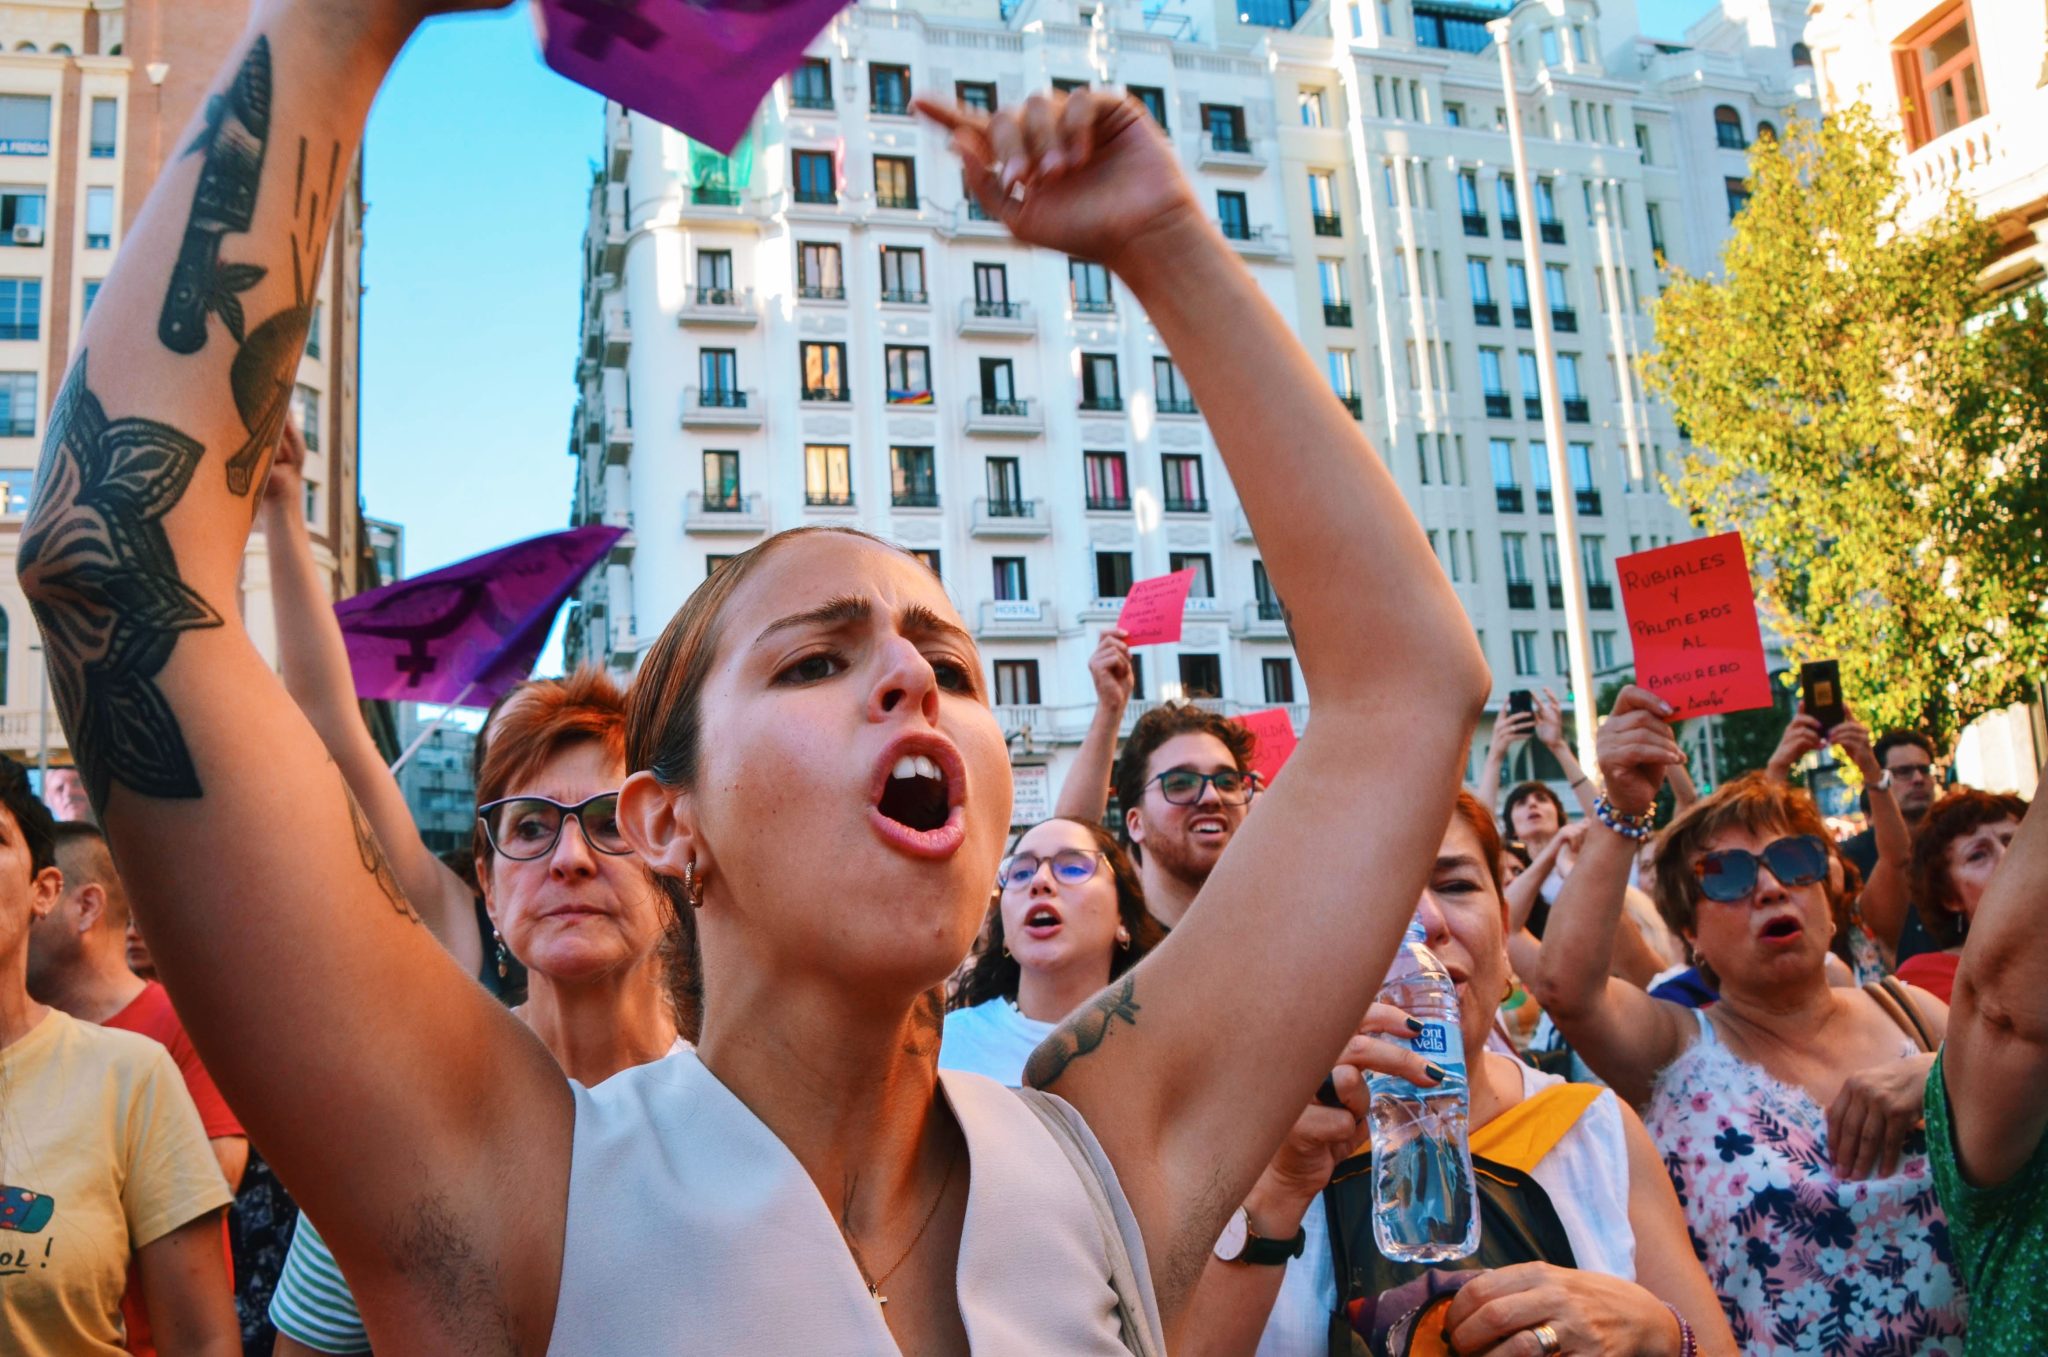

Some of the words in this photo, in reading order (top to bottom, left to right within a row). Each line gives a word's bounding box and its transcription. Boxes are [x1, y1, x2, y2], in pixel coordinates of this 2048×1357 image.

[1624, 553, 1725, 591] RUBIALES
[1670, 586, 1679, 603] Y
[995, 605, 1036, 615] HOSTAL
[1634, 603, 1732, 636] PALMEROS
[1682, 636, 1706, 651] AL
[1648, 662, 1740, 689] BASURERO
[1420, 1028, 1442, 1038] ont
[1415, 1038, 1444, 1050] Vella
